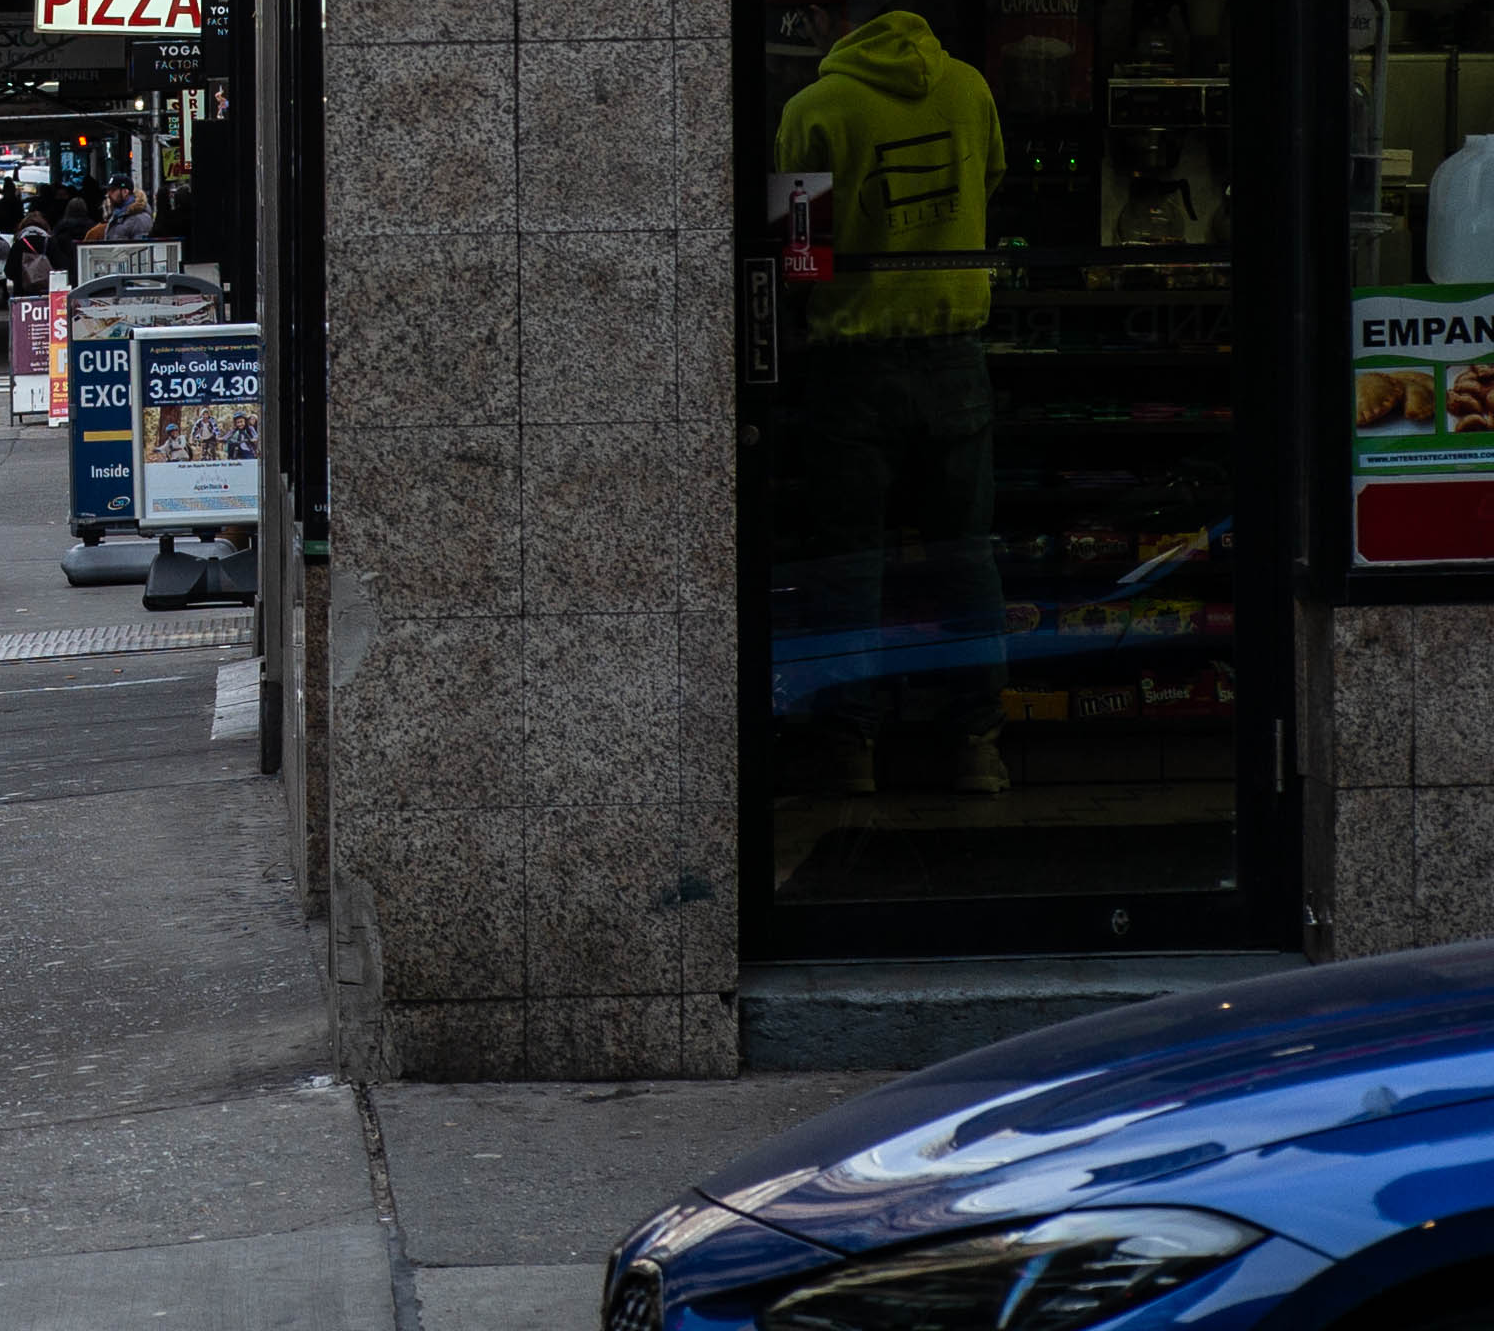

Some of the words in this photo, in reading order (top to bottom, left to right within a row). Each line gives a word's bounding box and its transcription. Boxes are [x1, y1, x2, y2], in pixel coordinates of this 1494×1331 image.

[159, 45, 201, 56] YOGA
[155, 59, 199, 70] FACTOR
[169, 73, 191, 83] NYC
[887, 198, 962, 228] ELITE
[784, 255, 818, 273] PULL
[750, 271, 769, 371] PULL
[80, 349, 129, 374] CUR
[150, 361, 186, 375] Apple
[189, 360, 218, 373] Gold
[220, 359, 259, 373] Saving
[80, 384, 131, 408] EXC
[150, 377, 207, 399] 3.50%
[211, 375, 258, 396] 4.30
[91, 464, 129, 478] Inside
[1144, 686, 1190, 705] Skittles
